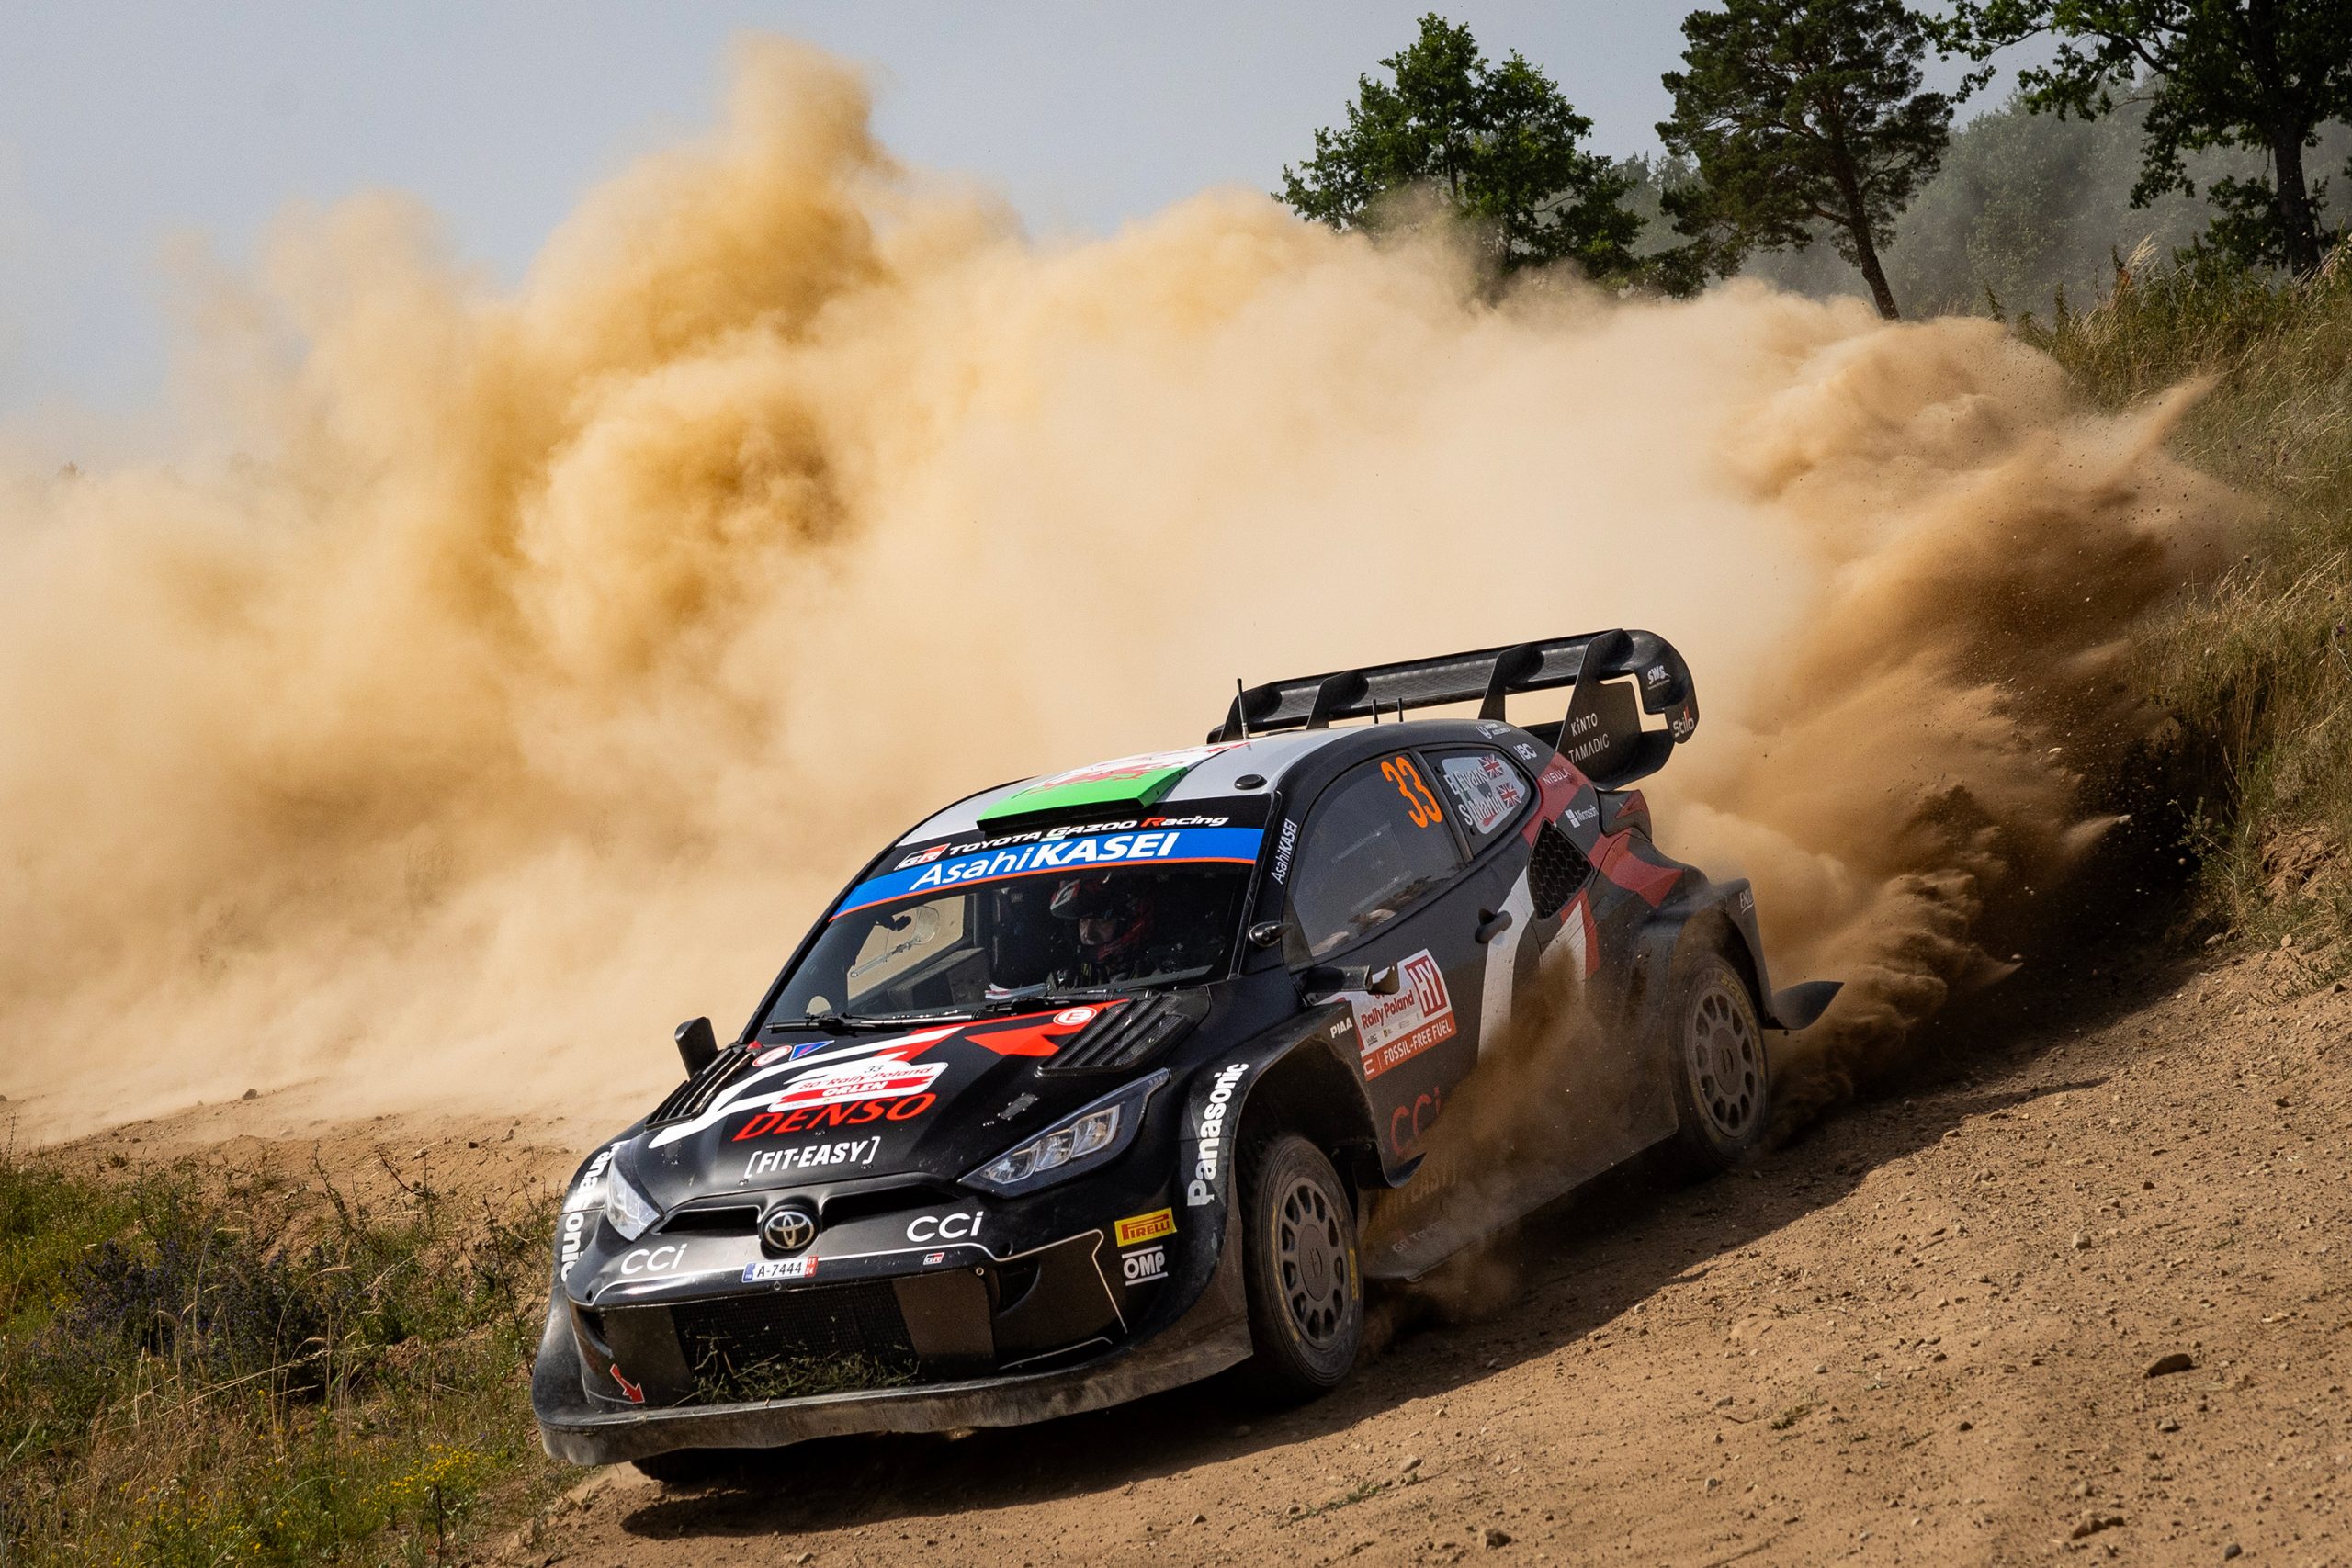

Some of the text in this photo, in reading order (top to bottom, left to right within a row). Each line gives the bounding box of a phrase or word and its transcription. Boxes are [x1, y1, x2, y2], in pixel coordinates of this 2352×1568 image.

[1672, 705, 1695, 738] Stilo
[1567, 734, 1610, 764] TAMADIC
[1380, 755, 1443, 828] 33
[1542, 768, 1572, 786] NISULA
[948, 832, 1042, 856] TOYOTA
[1046, 820, 1138, 841] GAZOO
[1140, 815, 1230, 829] Racing
[1271, 818, 1297, 885] AsahiKASEI
[908, 832, 1180, 891] AsahiKASEI
[1408, 960, 1442, 1013] HY
[1329, 1017, 1353, 1039] PIAA
[1361, 989, 1415, 1030] Rally Poland
[1383, 1029, 1432, 1065] FOSSIL-FREE
[1431, 1018, 1452, 1039] FUEL
[822, 1080, 888, 1097] ORLEN
[827, 1073, 865, 1088] Rally
[874, 1066, 933, 1079] Poland
[864, 1063, 884, 1074] 33
[733, 1093, 937, 1142] DENSO
[1187, 1063, 1250, 1207] Panasonic
[743, 1135, 881, 1179] [FIT-EASY]
[560, 1139, 632, 1283] Panaonic
[1121, 1213, 1170, 1241] PIRELLI
[756, 1261, 803, 1278] A-7444
[1123, 1251, 1166, 1280] OMP
